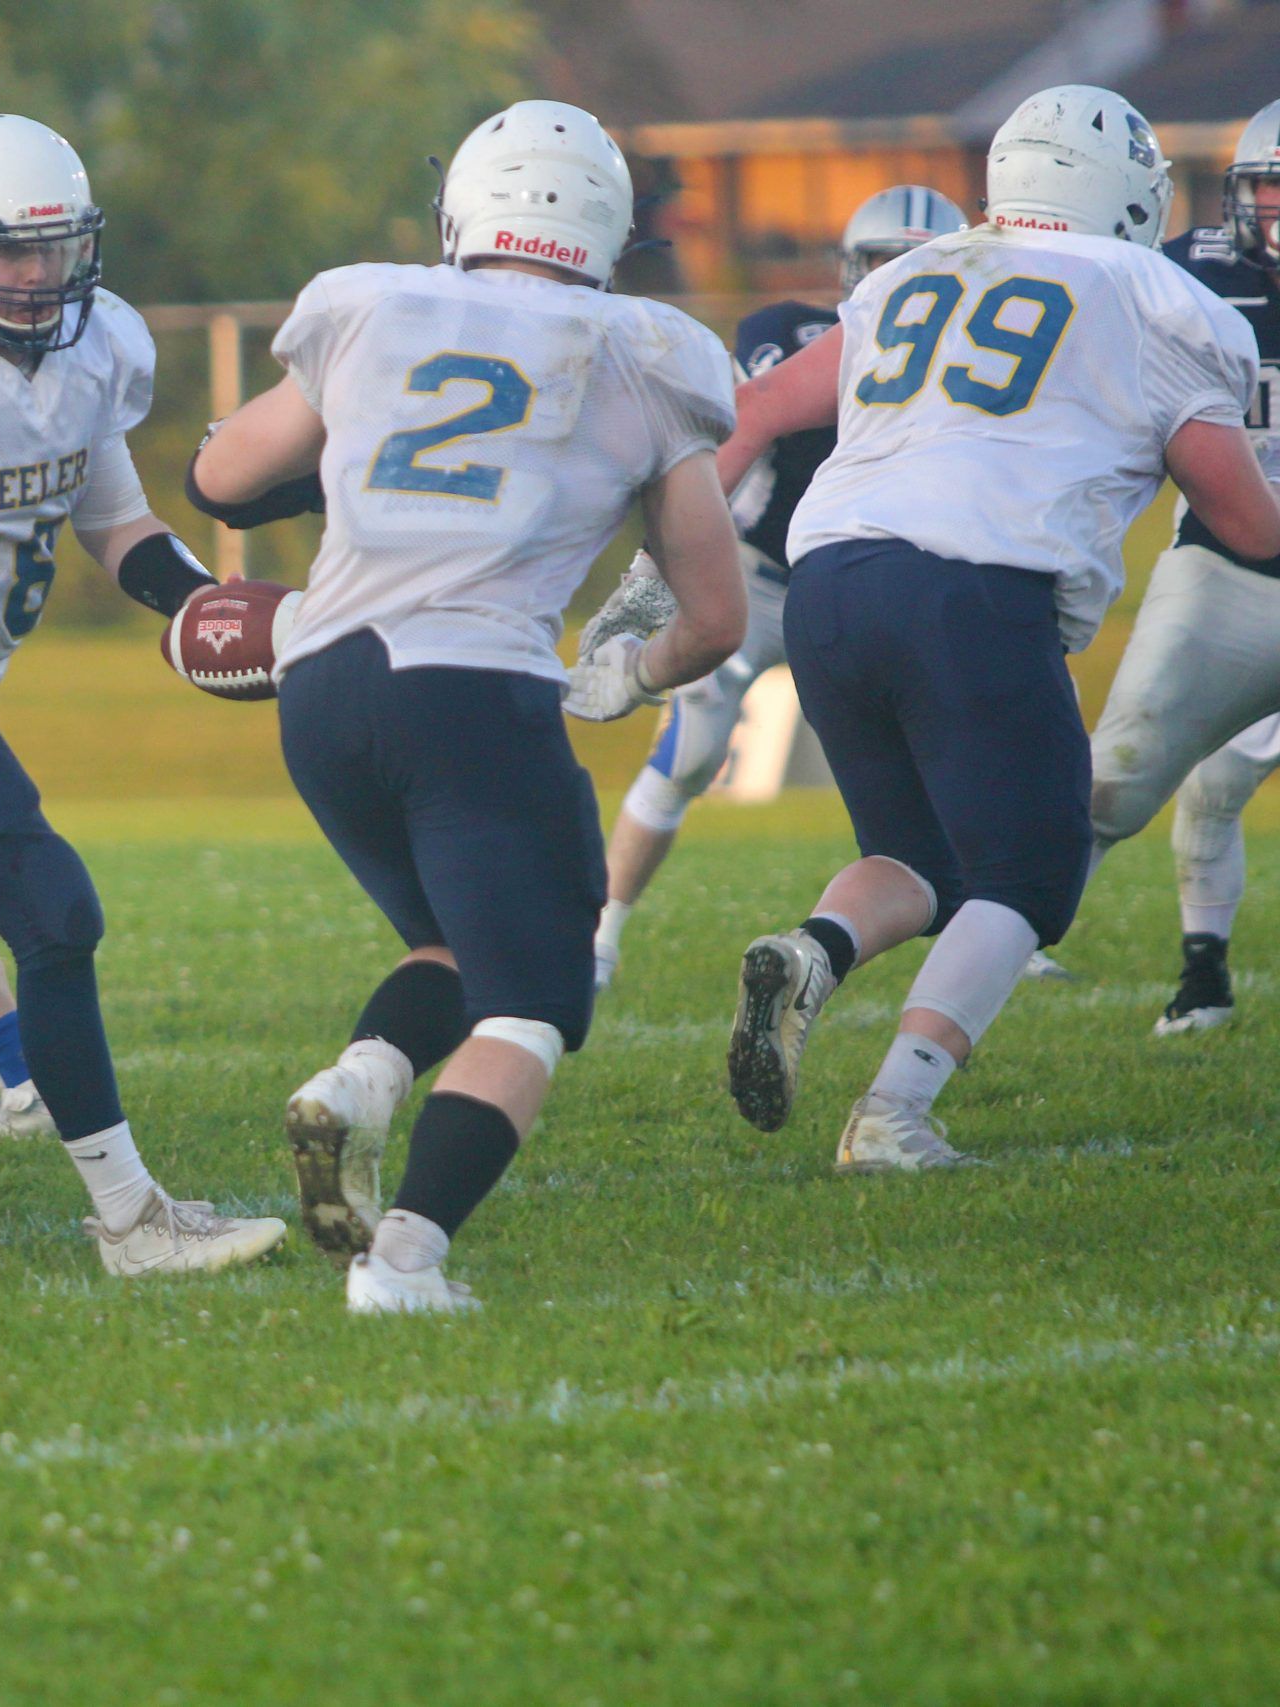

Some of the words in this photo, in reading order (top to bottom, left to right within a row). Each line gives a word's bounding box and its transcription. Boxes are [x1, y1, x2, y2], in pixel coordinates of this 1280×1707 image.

[28, 203, 64, 217] Riddell
[494, 230, 588, 268] Riddell
[854, 272, 1079, 419] 99
[360, 348, 539, 506] 2
[198, 619, 242, 632] ROUGE
